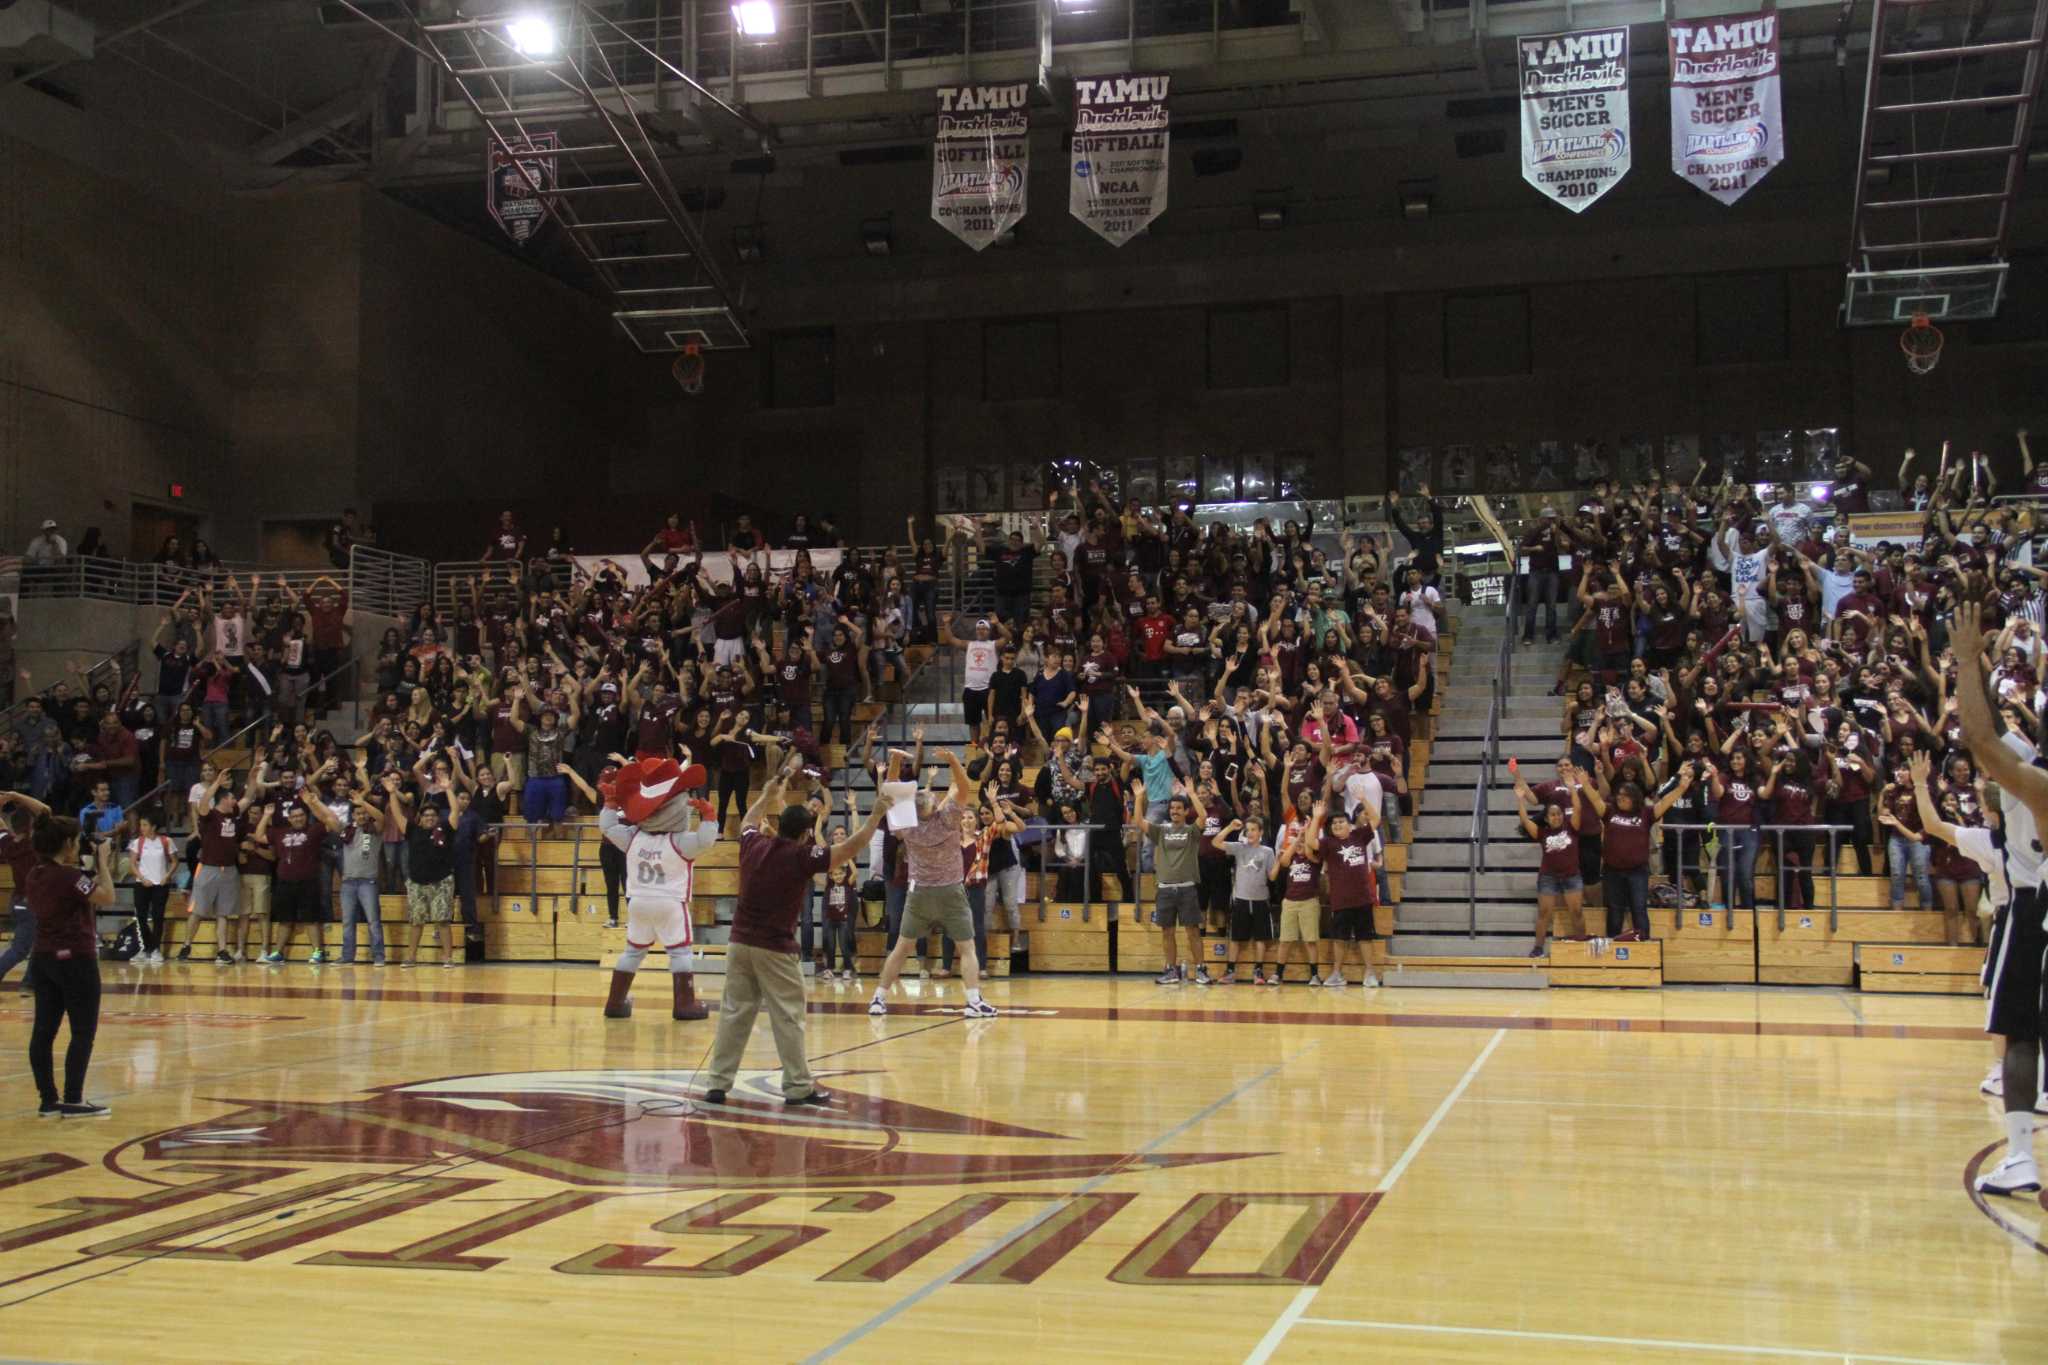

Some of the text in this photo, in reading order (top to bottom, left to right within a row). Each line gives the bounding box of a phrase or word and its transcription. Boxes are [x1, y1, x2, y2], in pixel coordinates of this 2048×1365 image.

[1670, 16, 1775, 54] TAMIU
[1522, 32, 1624, 66] TAMIU
[1673, 48, 1776, 82] Dustdevils
[1524, 62, 1626, 95] Dustdevils
[936, 84, 1028, 111] TAMIU
[1076, 76, 1170, 105] TAMIU
[1696, 87, 1754, 107] MEN'S
[1550, 94, 1605, 112] MEN'S
[1075, 104, 1168, 132] Dustdevils
[1540, 112, 1611, 130] SOCCER
[1691, 103, 1761, 124] SOCCER
[937, 112, 1027, 138] Dustdevils
[937, 145, 1024, 163] SOFTBALL
[1073, 136, 1164, 153] SOFTBALL
[1537, 167, 1617, 183] CHAMPIONS
[1687, 156, 1768, 176] CHAMPIONS
[1099, 181, 1139, 194] NCAA
[1557, 182, 1598, 198] 2010
[1709, 175, 1747, 191] 2011
[1104, 221, 1134, 232] 2011
